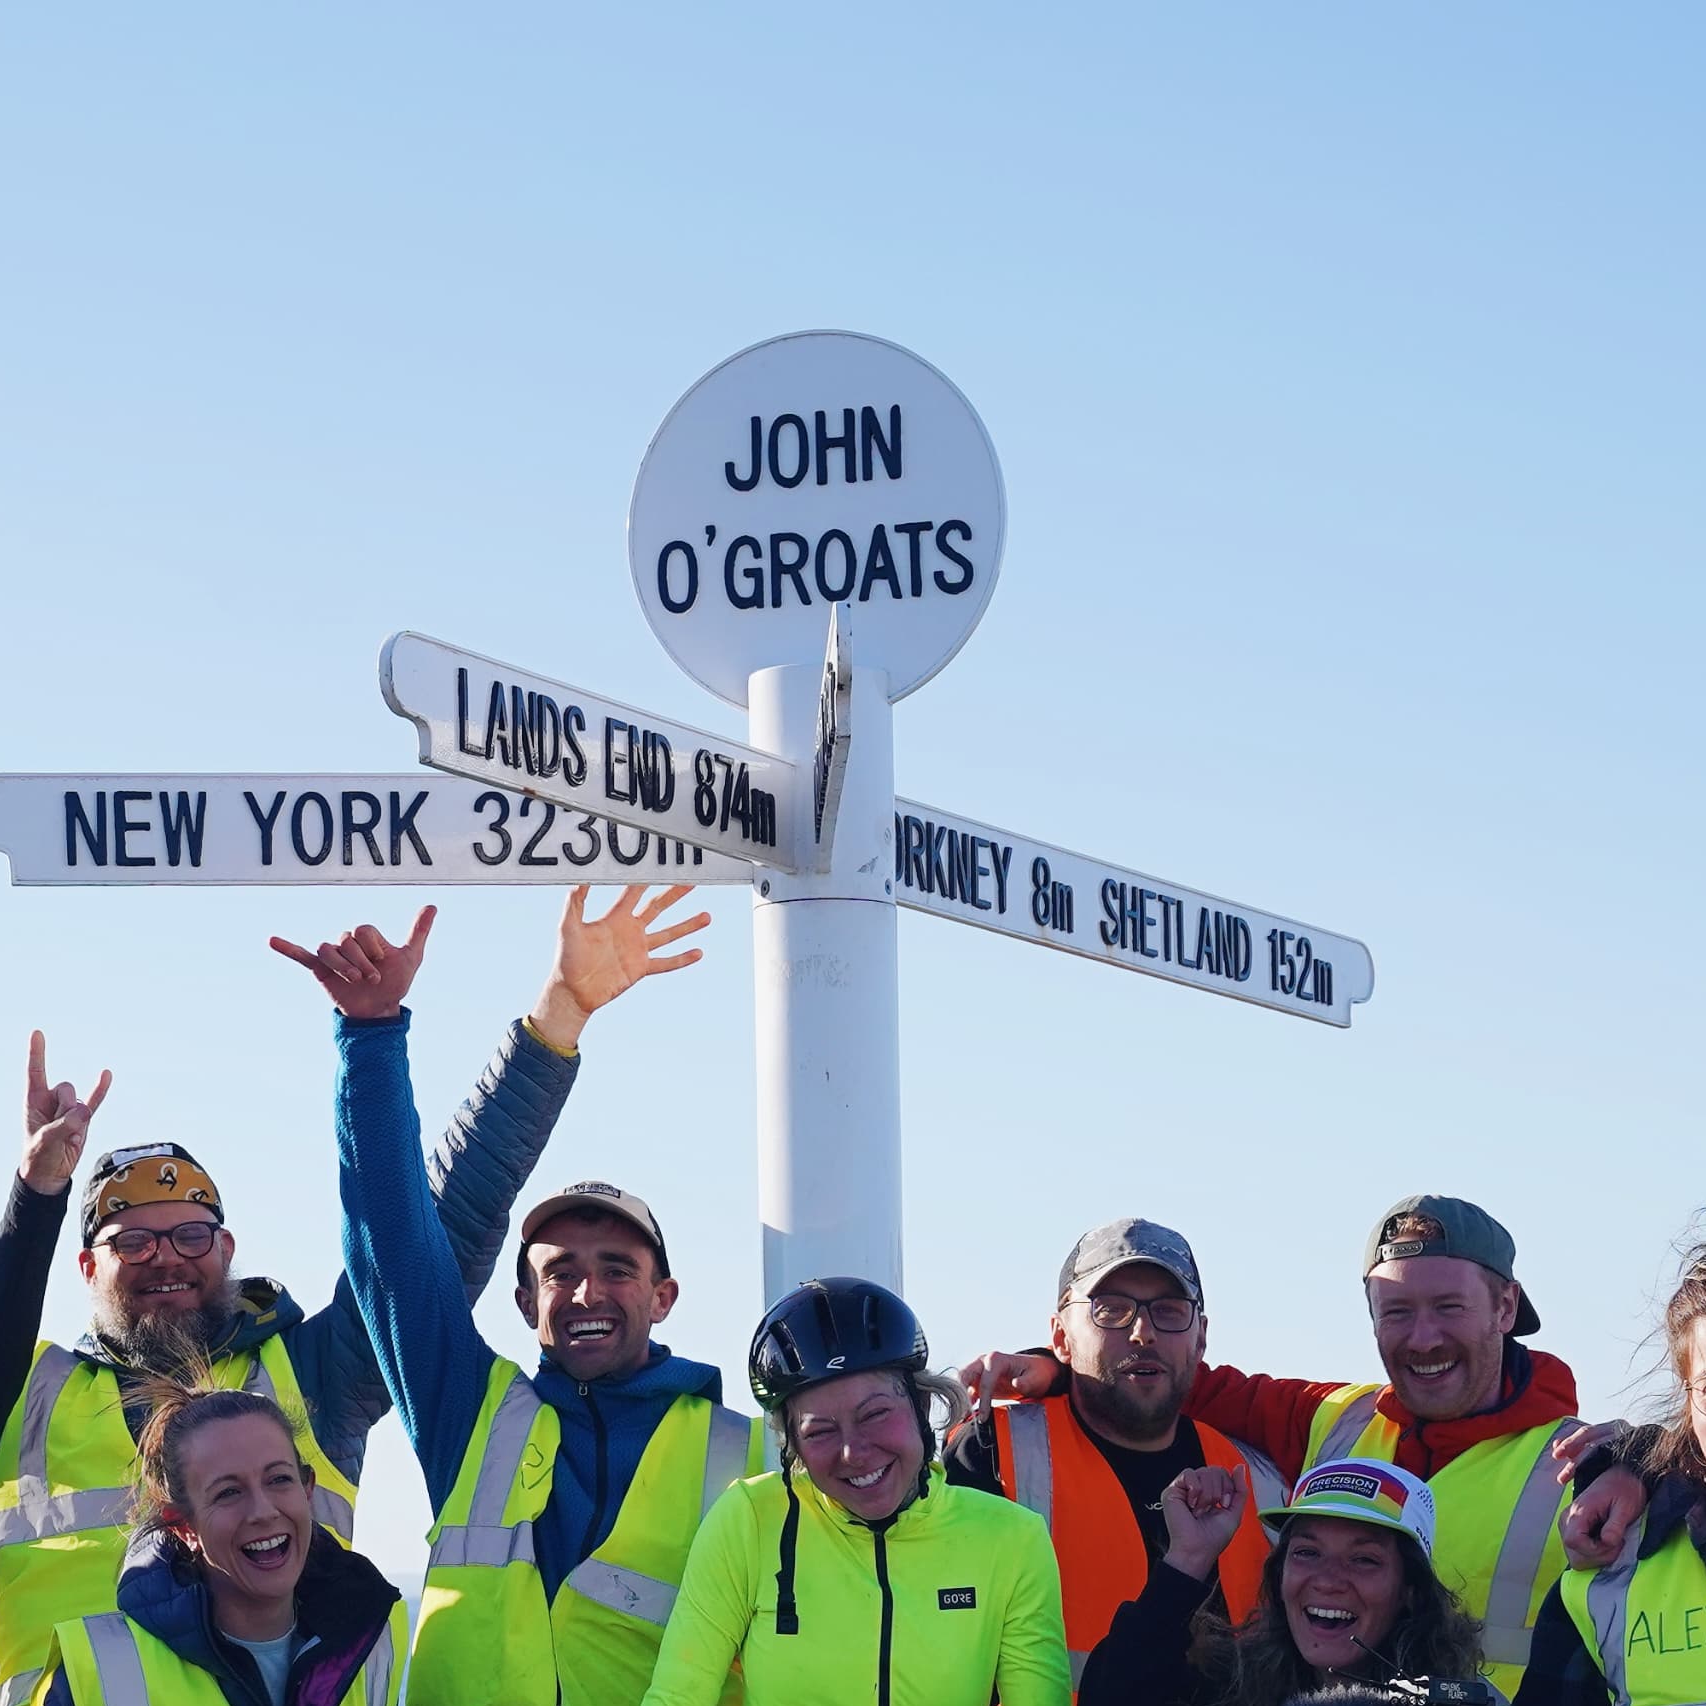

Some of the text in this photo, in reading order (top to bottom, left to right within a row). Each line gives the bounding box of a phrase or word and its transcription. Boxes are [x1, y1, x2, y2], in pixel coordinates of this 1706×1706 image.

[725, 404, 902, 491] JOHN
[657, 519, 974, 614] O'GROATS
[457, 667, 587, 787] LANDS
[605, 716, 676, 813] END
[693, 748, 777, 847] 874m
[64, 790, 207, 867] NEW
[243, 790, 433, 867] YORK
[1031, 856, 1075, 934] 8m
[1099, 877, 1253, 982] SHETLAND
[1267, 927, 1334, 1006] 152m
[1309, 1476, 1374, 1490] PRECISION
[943, 1593, 972, 1604] GORE
